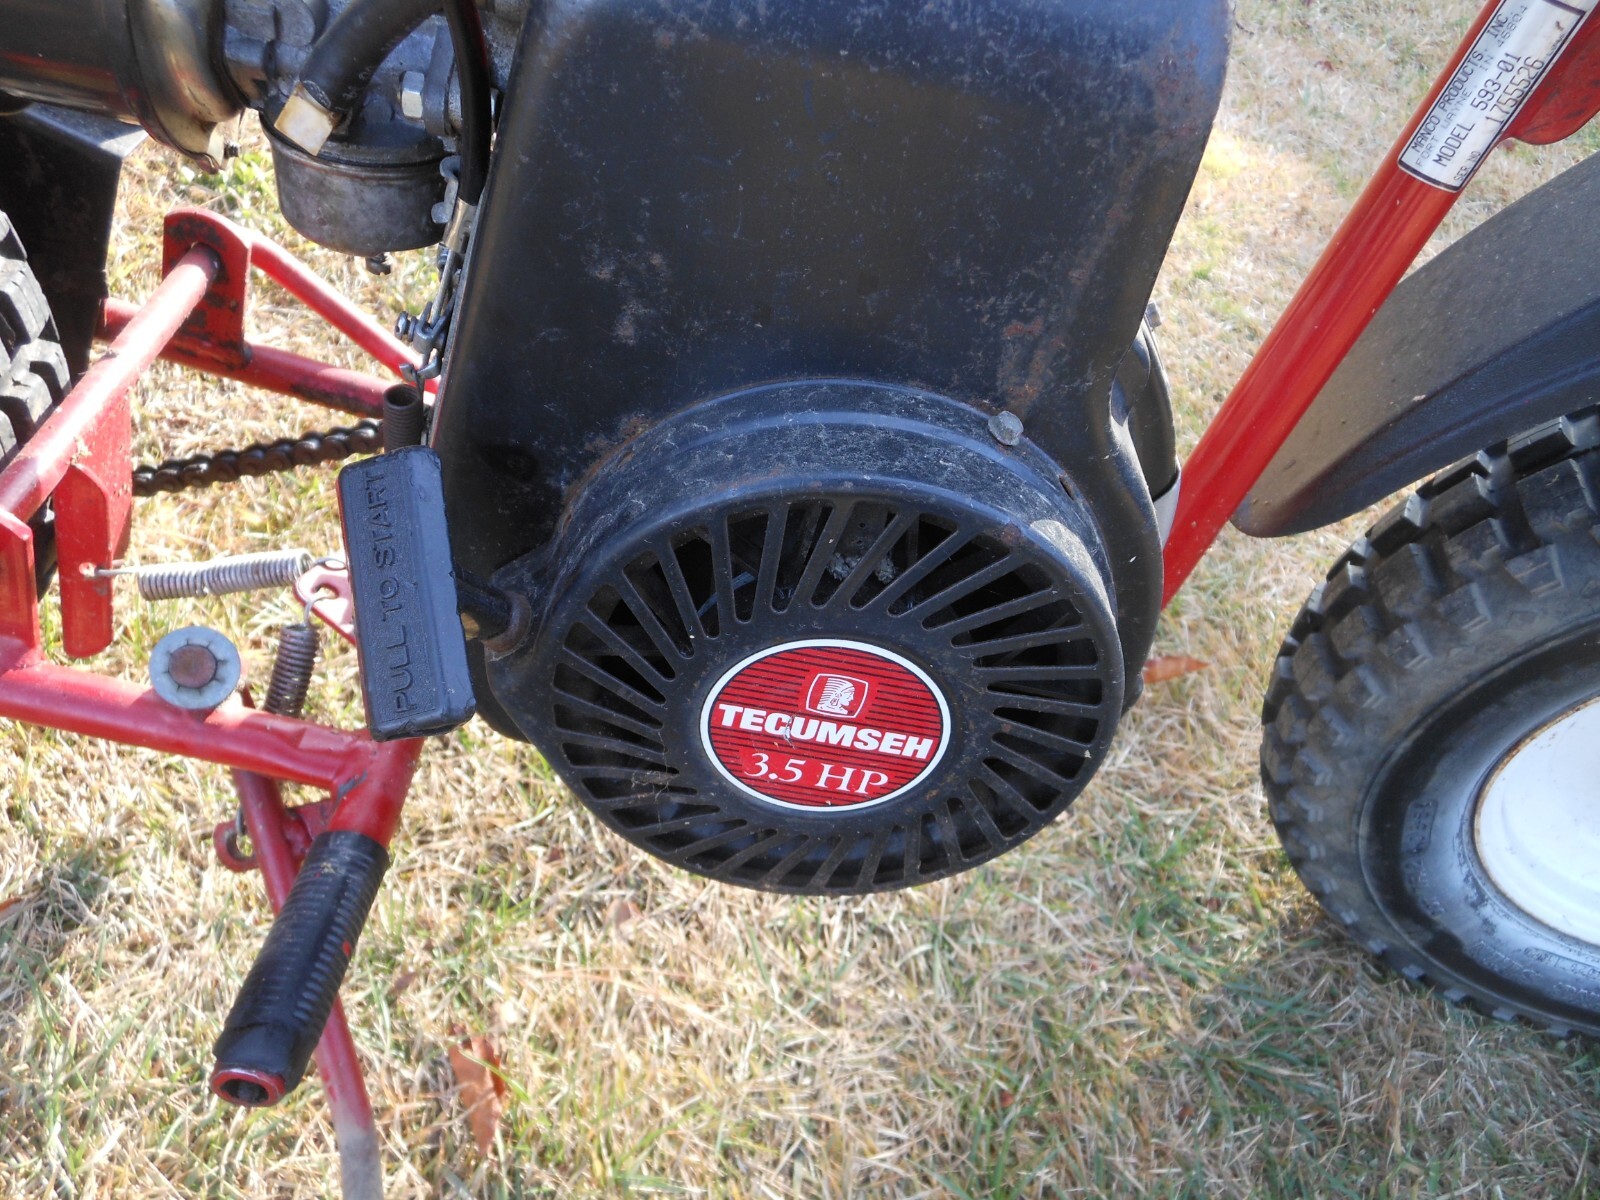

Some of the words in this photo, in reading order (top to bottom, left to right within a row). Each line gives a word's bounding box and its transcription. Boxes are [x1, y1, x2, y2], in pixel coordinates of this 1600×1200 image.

[1415, 135, 1437, 167] FORT
[1478, 54, 1495, 72] IN
[1433, 121, 1476, 168] MODEL
[1470, 52, 1522, 113] 593-01
[1485, 56, 1545, 126] 1755526
[1411, 115, 1441, 154] MANCO
[363, 471, 396, 568] START
[378, 577, 403, 622] TO
[386, 624, 418, 714] PULL
[718, 703, 934, 760] TECUMSEH
[743, 752, 806, 783] 3.5
[815, 762, 889, 795] HP
